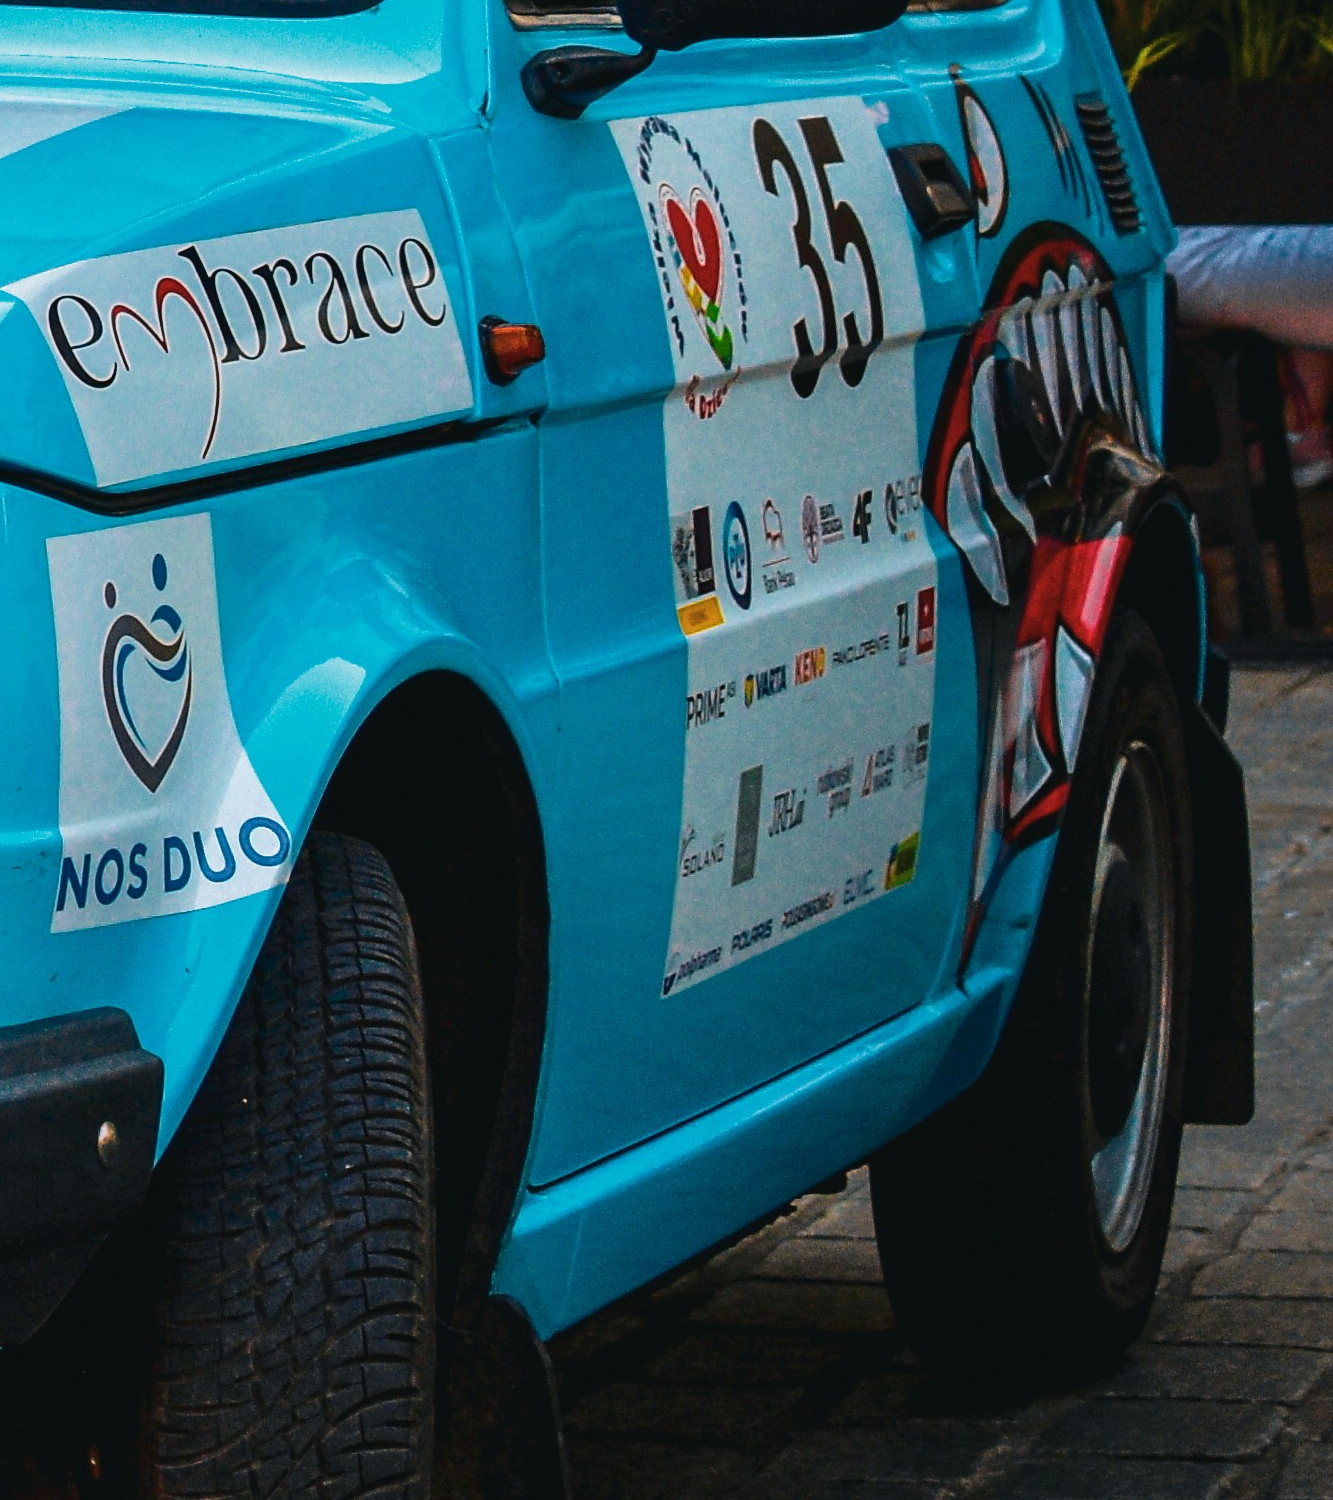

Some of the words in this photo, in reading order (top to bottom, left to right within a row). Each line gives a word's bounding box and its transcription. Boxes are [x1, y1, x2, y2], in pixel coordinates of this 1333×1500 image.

[47, 237, 447, 459] embrace
[751, 116, 884, 399] 35
[55, 841, 149, 912] NOS
[163, 816, 291, 893] DUO
